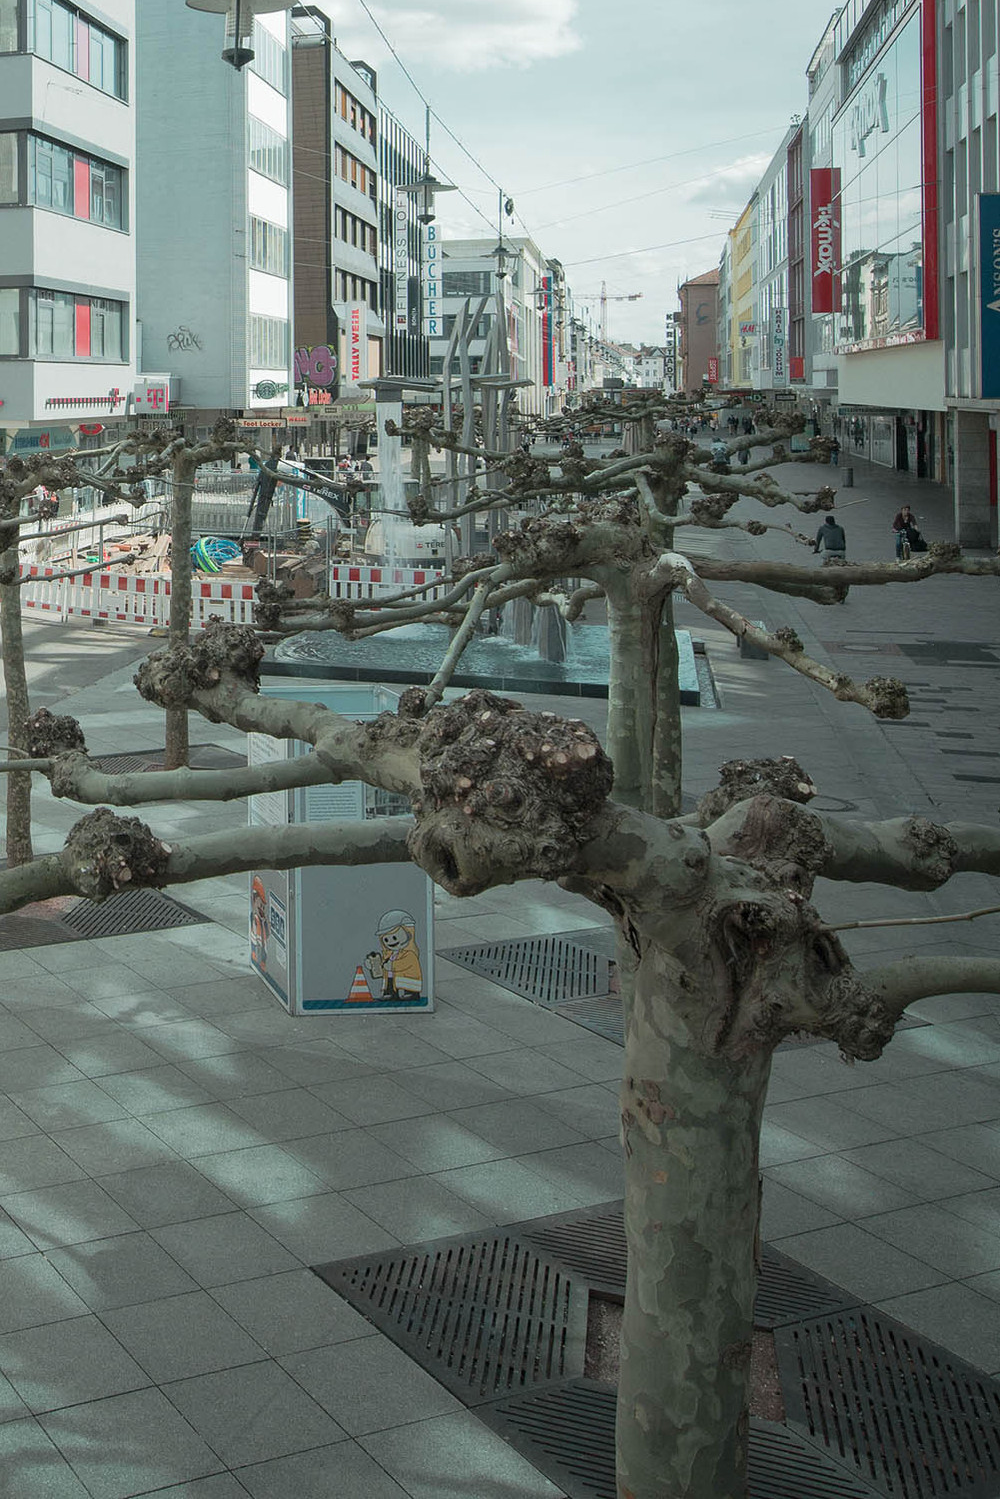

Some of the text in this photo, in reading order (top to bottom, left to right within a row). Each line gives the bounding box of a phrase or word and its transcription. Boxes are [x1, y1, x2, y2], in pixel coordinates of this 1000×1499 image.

[396, 238, 407, 312] FITNESS
[427, 226, 438, 335] BÜCHER
[351, 347, 360, 381] TALLY
[260, 420, 282, 428] Locker
[425, 541, 446, 549] TERE
